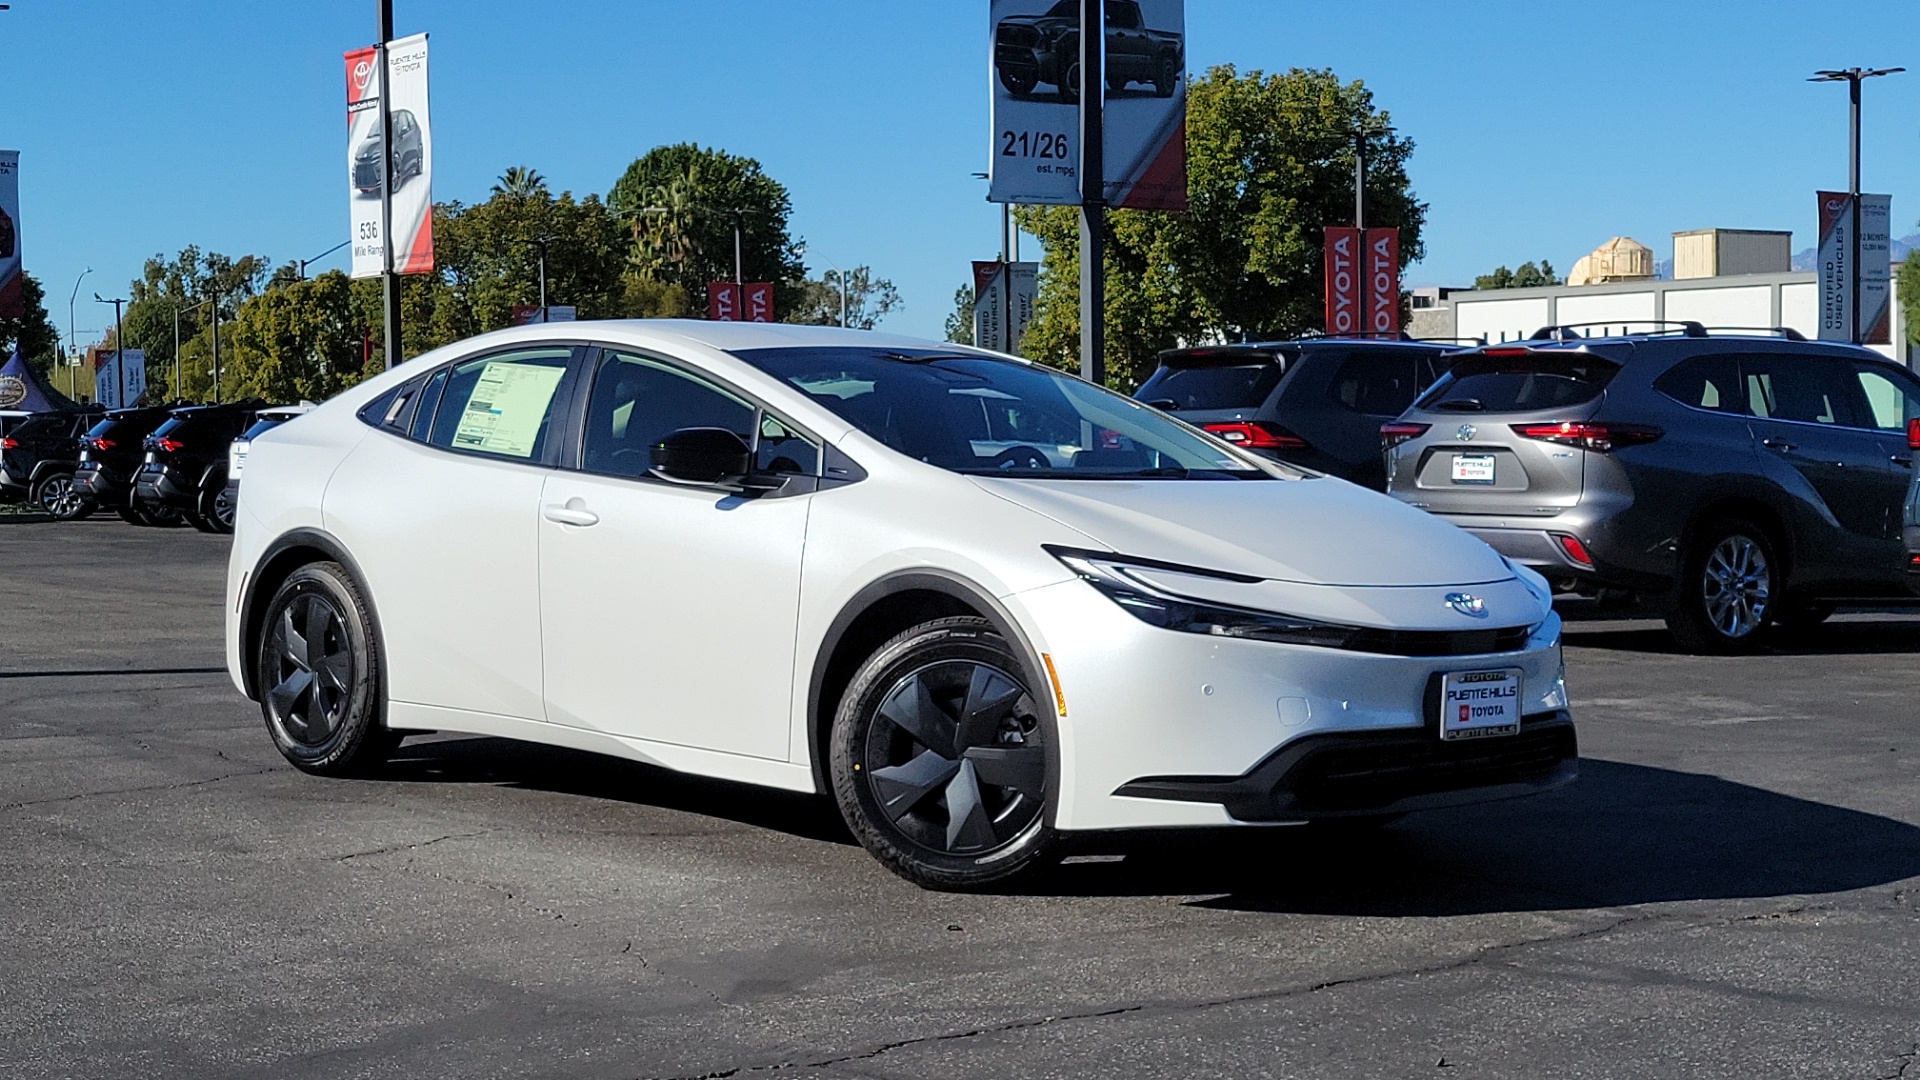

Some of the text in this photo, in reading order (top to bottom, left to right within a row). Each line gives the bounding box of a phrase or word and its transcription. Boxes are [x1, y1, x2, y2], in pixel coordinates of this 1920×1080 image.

[402, 62, 421, 72] TOYOTA
[1002, 130, 1068, 160] 21/26
[1036, 164, 1075, 176] est. mpg
[360, 221, 378, 240] 536
[354, 245, 385, 257] Mile Rang
[1335, 236, 1351, 332] OYOTA
[1835, 226, 1844, 330] USED VEHICLES
[1826, 261, 1834, 330] CERTIFIED
[1466, 672, 1504, 681] TOYOTA
[1448, 686, 1516, 701] PUENTE HILLS
[1471, 705, 1504, 718] TOYOTA
[1488, 725, 1515, 735] HILLS
